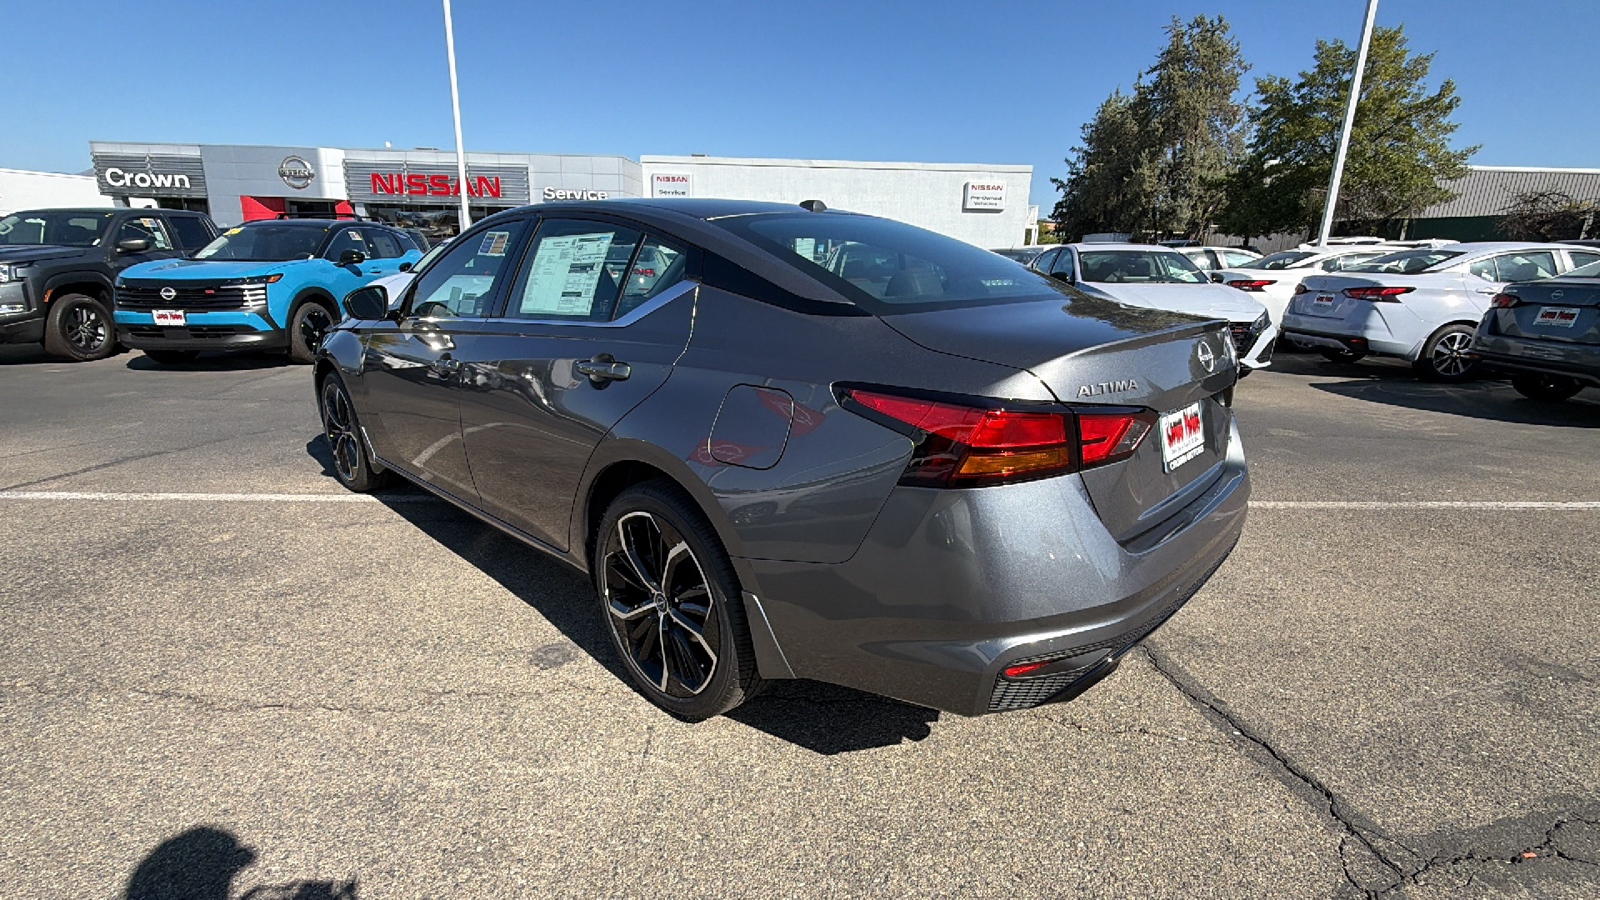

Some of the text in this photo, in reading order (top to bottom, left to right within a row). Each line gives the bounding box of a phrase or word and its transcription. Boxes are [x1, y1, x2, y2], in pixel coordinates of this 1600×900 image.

[105, 167, 191, 188] Crown
[370, 172, 501, 198] NISSAN
[543, 186, 608, 201] Service
[1076, 379, 1139, 398] ALTIMA
